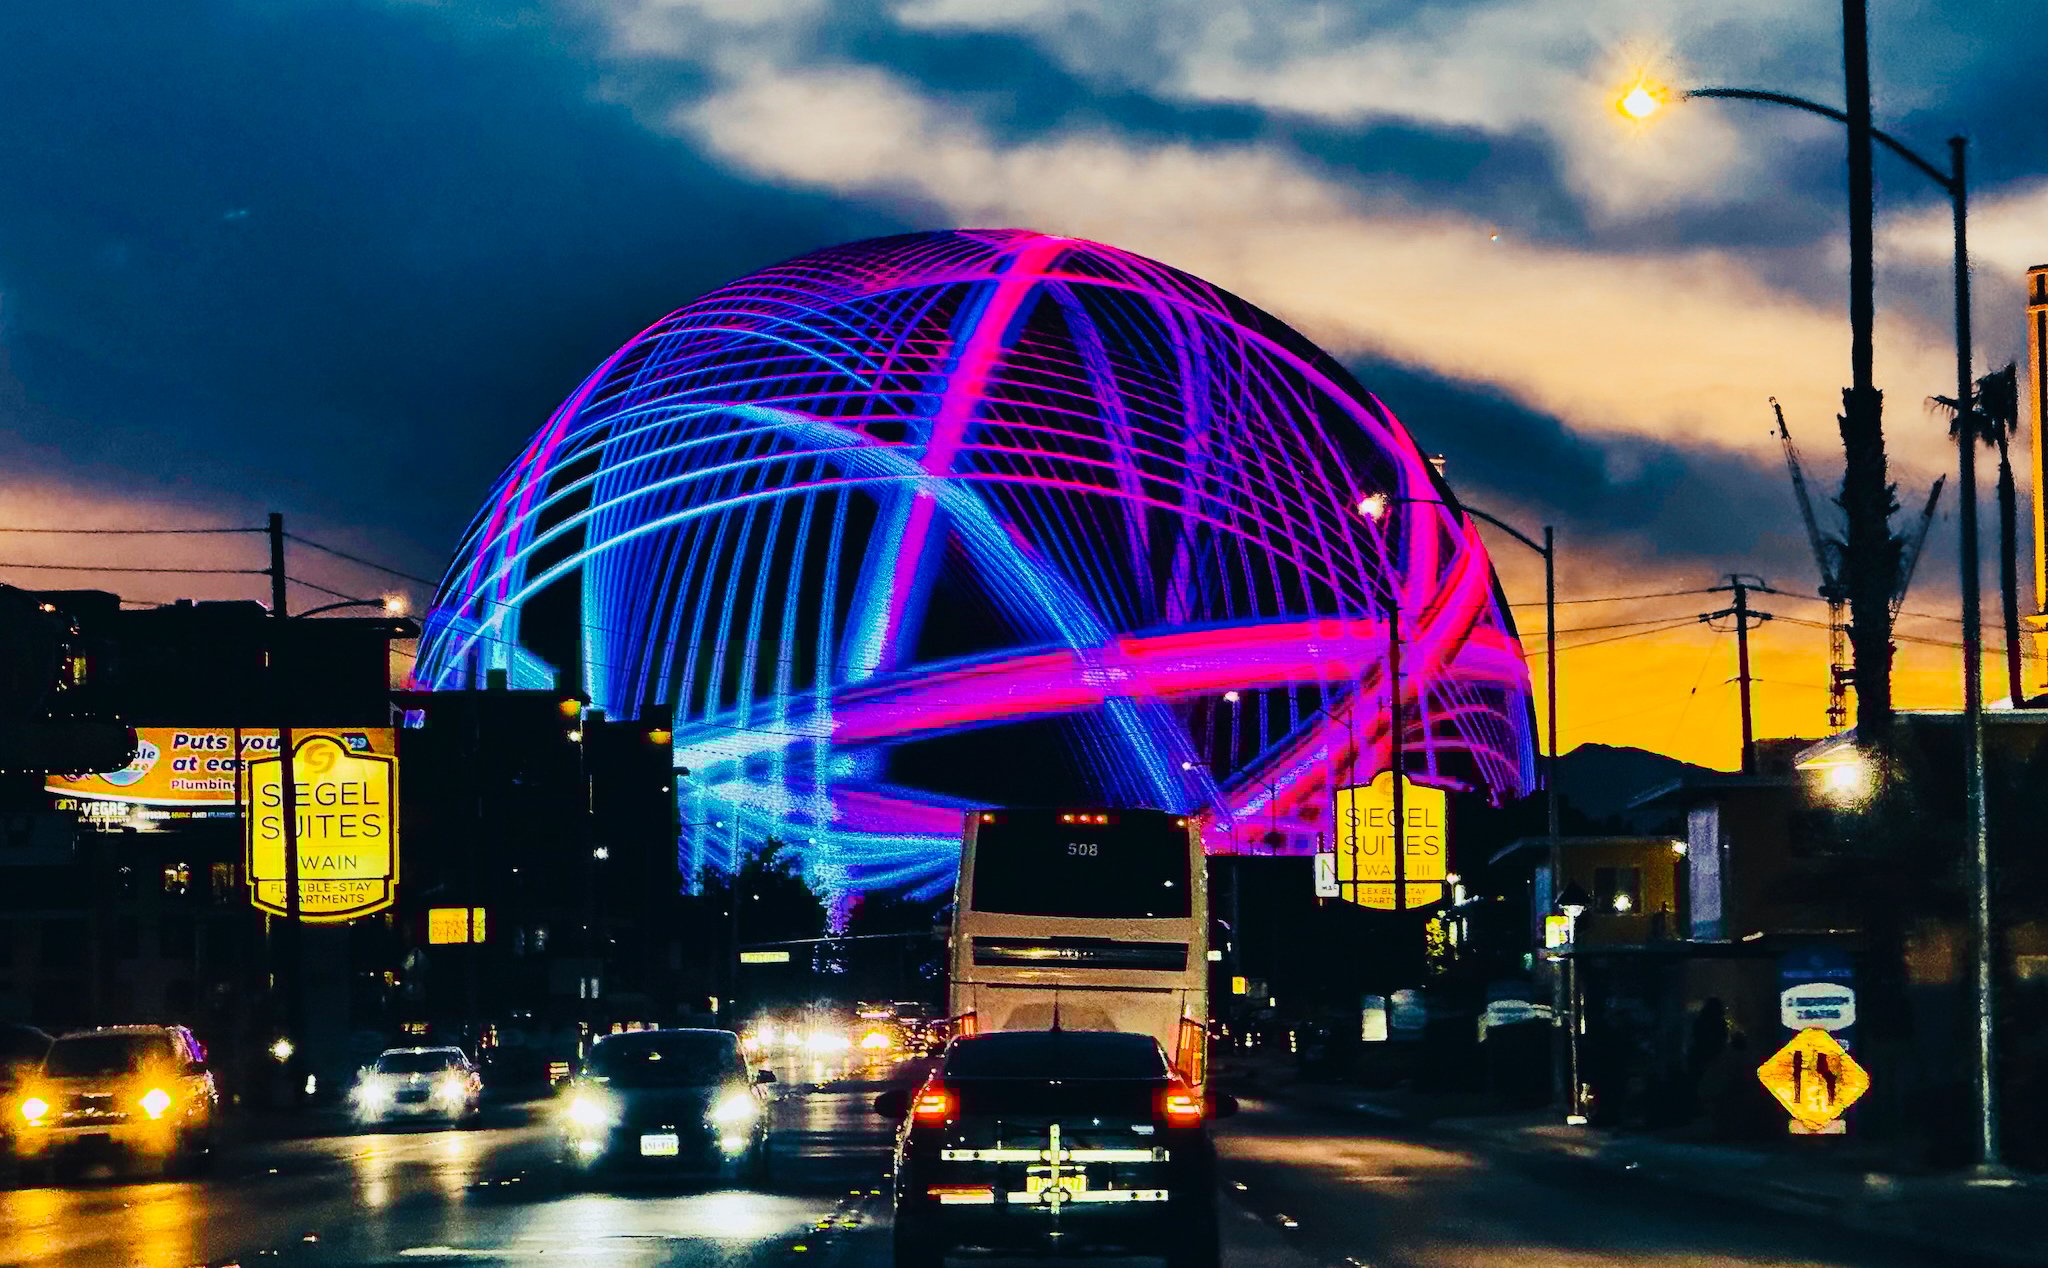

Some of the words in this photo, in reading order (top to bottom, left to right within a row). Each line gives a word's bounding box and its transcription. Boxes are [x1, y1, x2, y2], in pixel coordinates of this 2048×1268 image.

[173, 734, 228, 750] Puts
[172, 757, 198, 771] at
[206, 758, 247, 772] eas
[171, 779, 237, 790] Plumbin
[262, 781, 380, 808] SEGEL
[81, 801, 128, 817] VEGAS
[1067, 842, 1098, 857] 508
[300, 855, 357, 870] WAIN
[271, 881, 373, 894] FLIBLE-STAY
[280, 893, 365, 905] AARTMENTS
[1361, 897, 1422, 905] APARTTS
